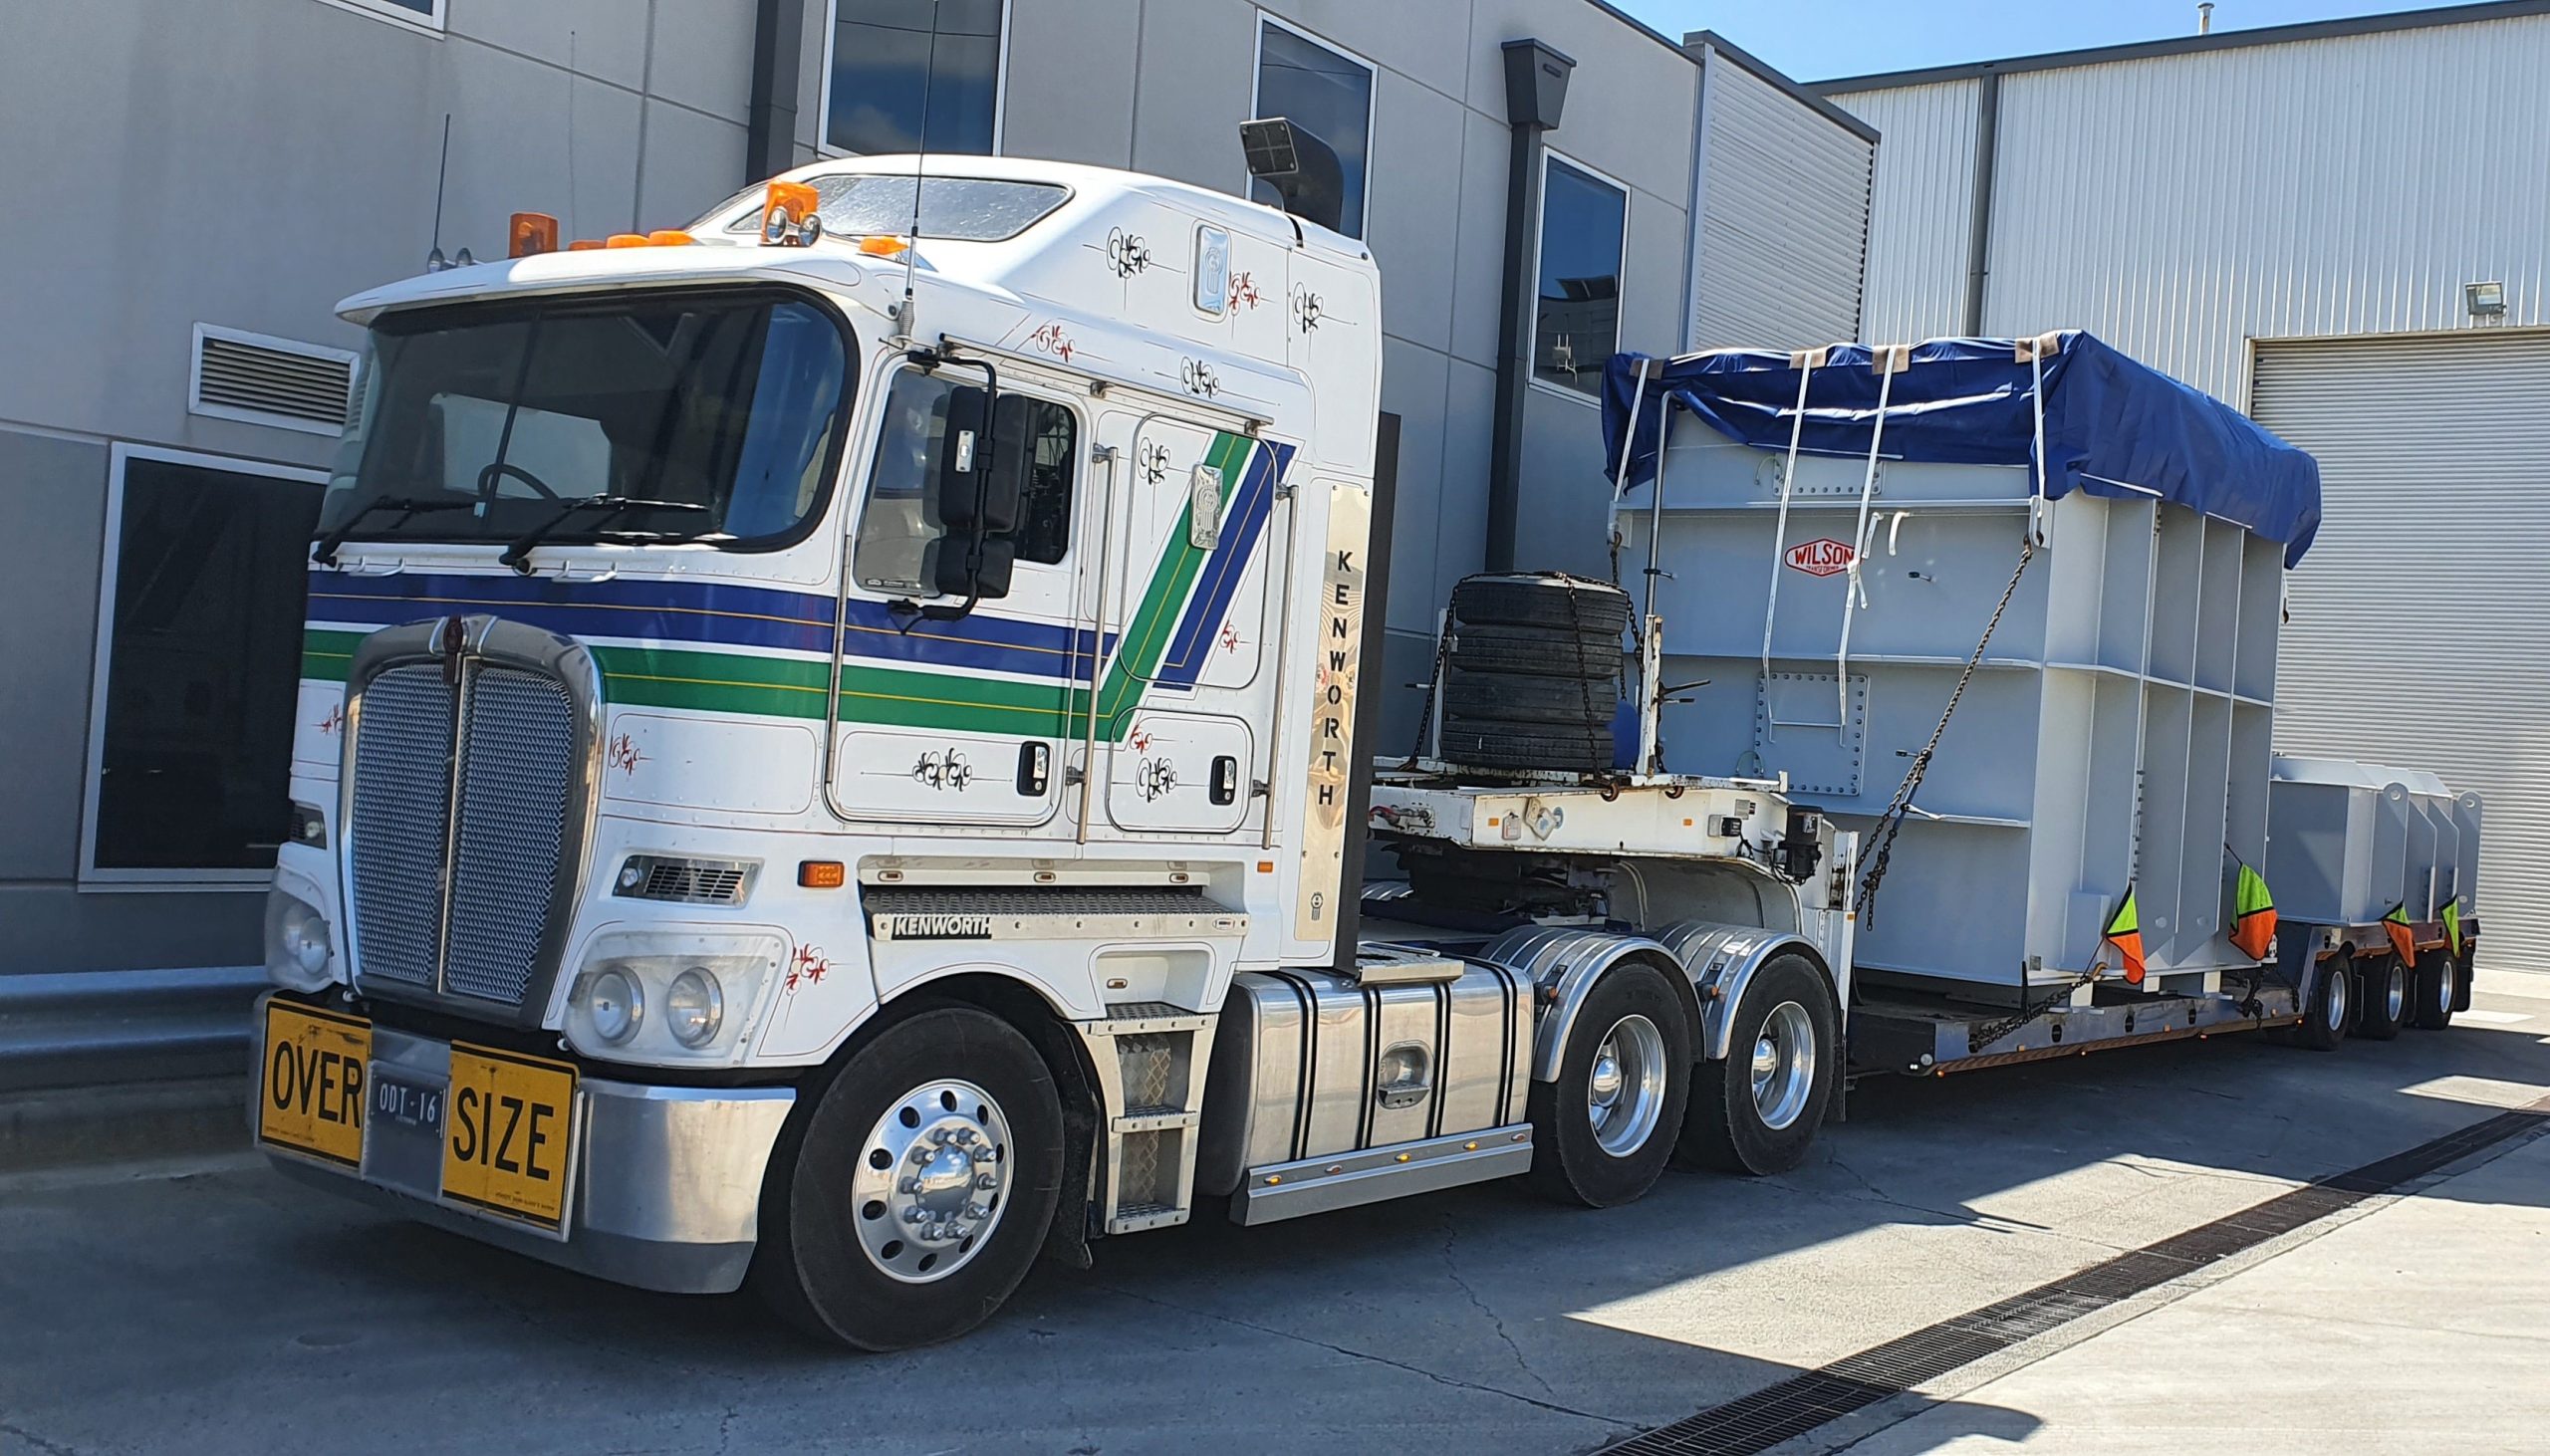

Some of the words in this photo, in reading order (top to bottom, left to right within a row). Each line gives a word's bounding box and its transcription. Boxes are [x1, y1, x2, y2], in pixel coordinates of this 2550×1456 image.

[1794, 543, 1855, 566] WILSON
[1318, 550, 1354, 806] KENWORTH
[894, 915, 993, 936] KENWORTH
[272, 1041, 364, 1129] OVER
[452, 1087, 555, 1181] SIZE
